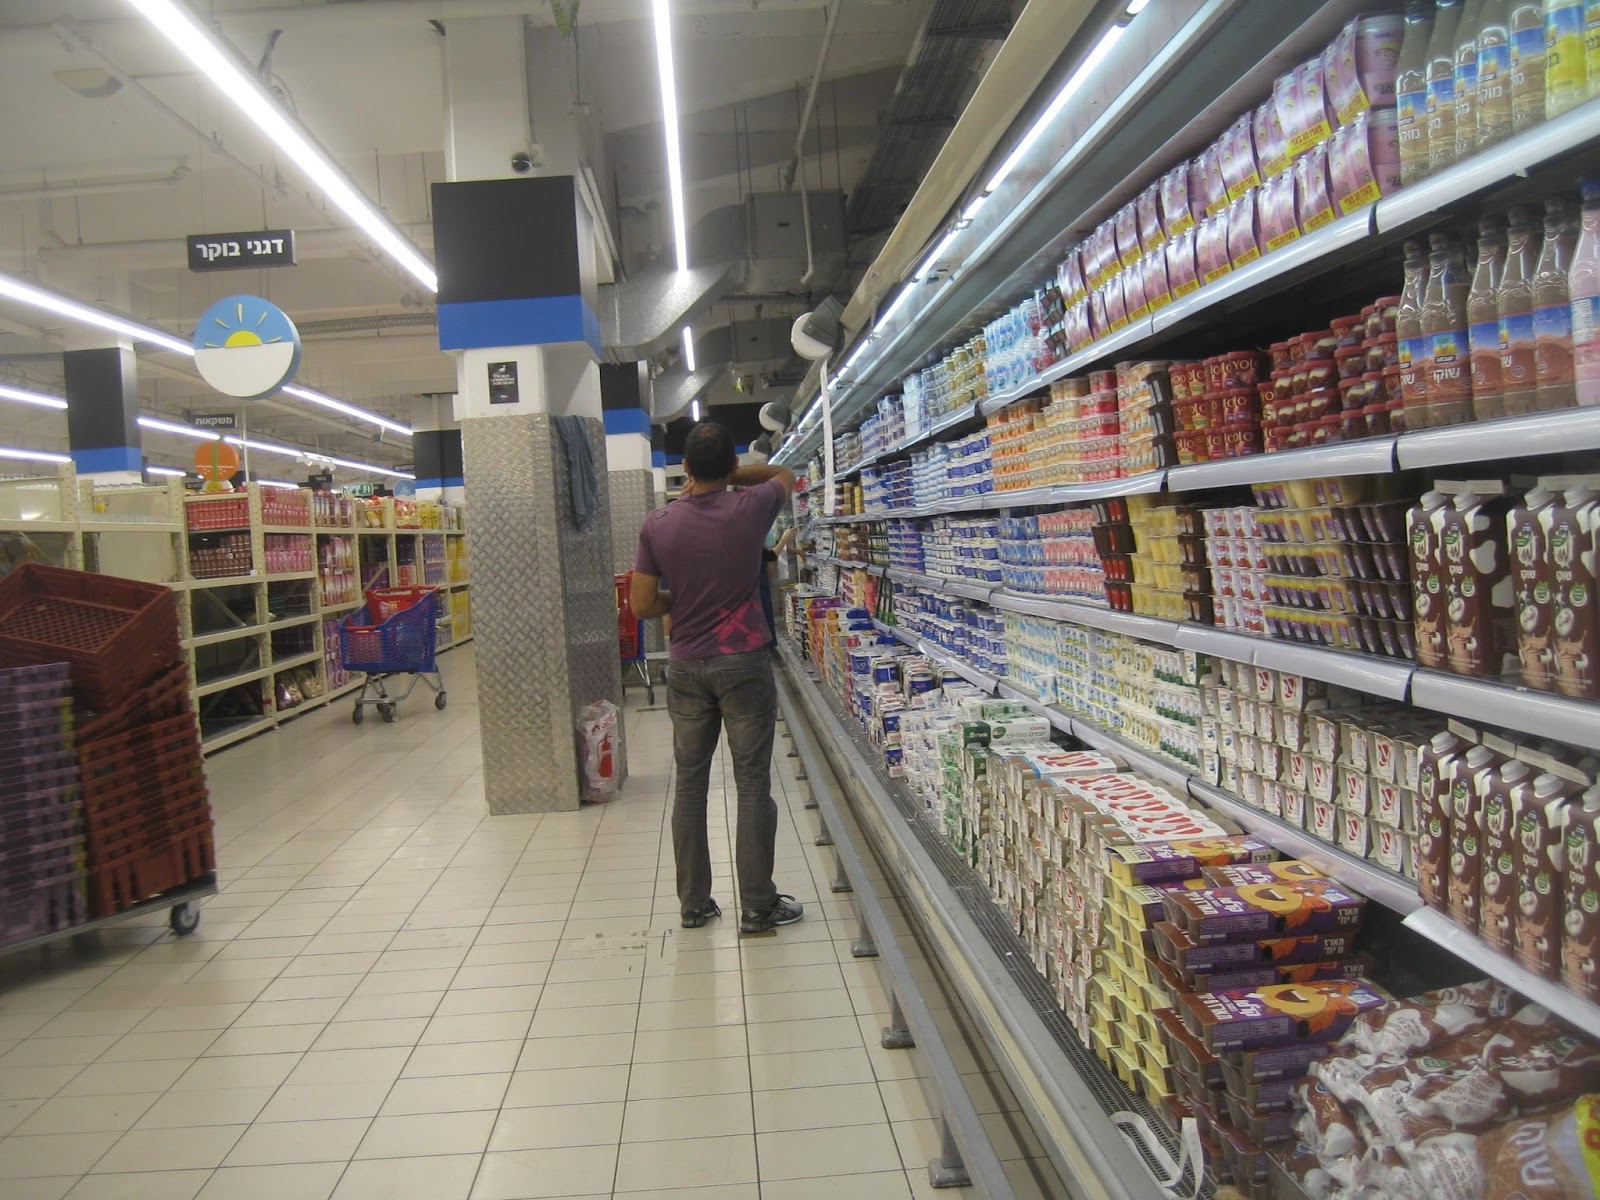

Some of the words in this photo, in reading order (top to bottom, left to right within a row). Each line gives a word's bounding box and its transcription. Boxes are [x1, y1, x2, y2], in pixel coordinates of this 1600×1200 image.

[196, 242, 241, 262] בוקר
[247, 239, 284, 255] דגני
[1433, 367, 1460, 384] שוקו
[195, 417, 233, 427] משקאות
[1520, 570, 1536, 581] שוקו
[1556, 571, 1572, 582] שוקו
[1338, 908, 1359, 916] מארז
[1323, 938, 1345, 947] מארז
